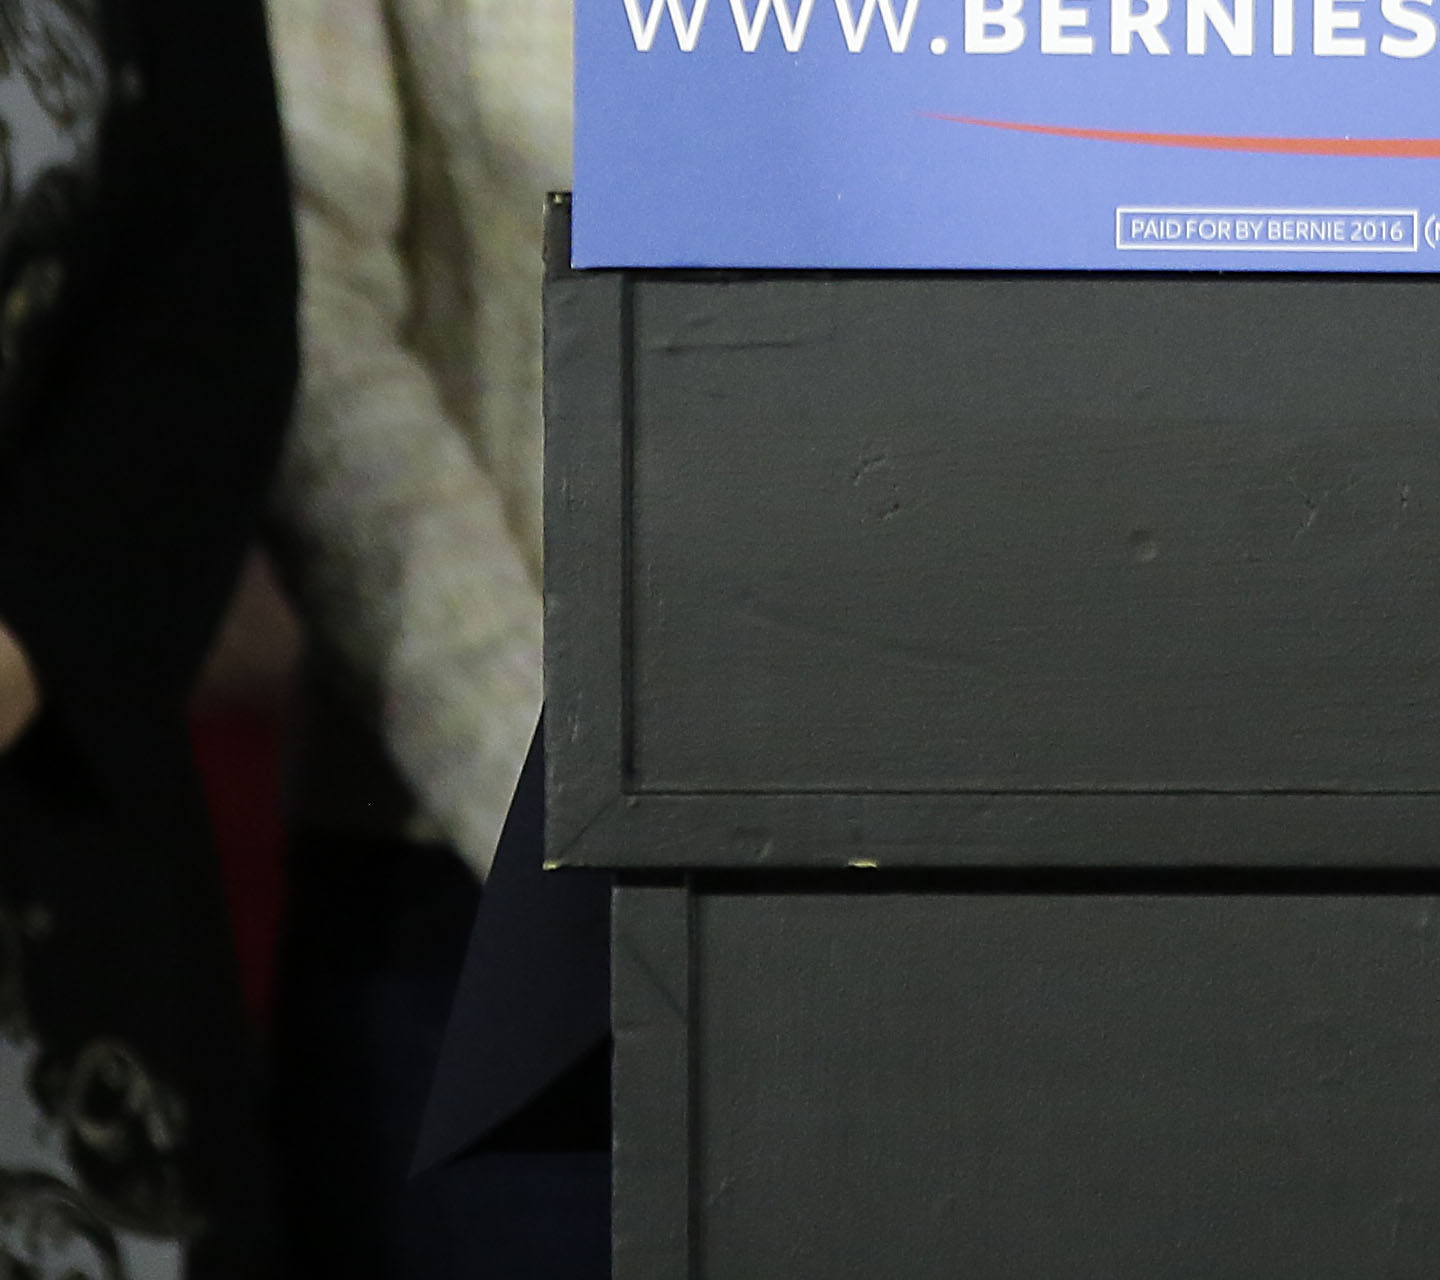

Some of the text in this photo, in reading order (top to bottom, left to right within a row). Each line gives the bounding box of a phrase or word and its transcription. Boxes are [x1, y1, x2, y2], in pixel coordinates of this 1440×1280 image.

[1131, 218, 1404, 242] PAID FOR BY BERNIE 2016
